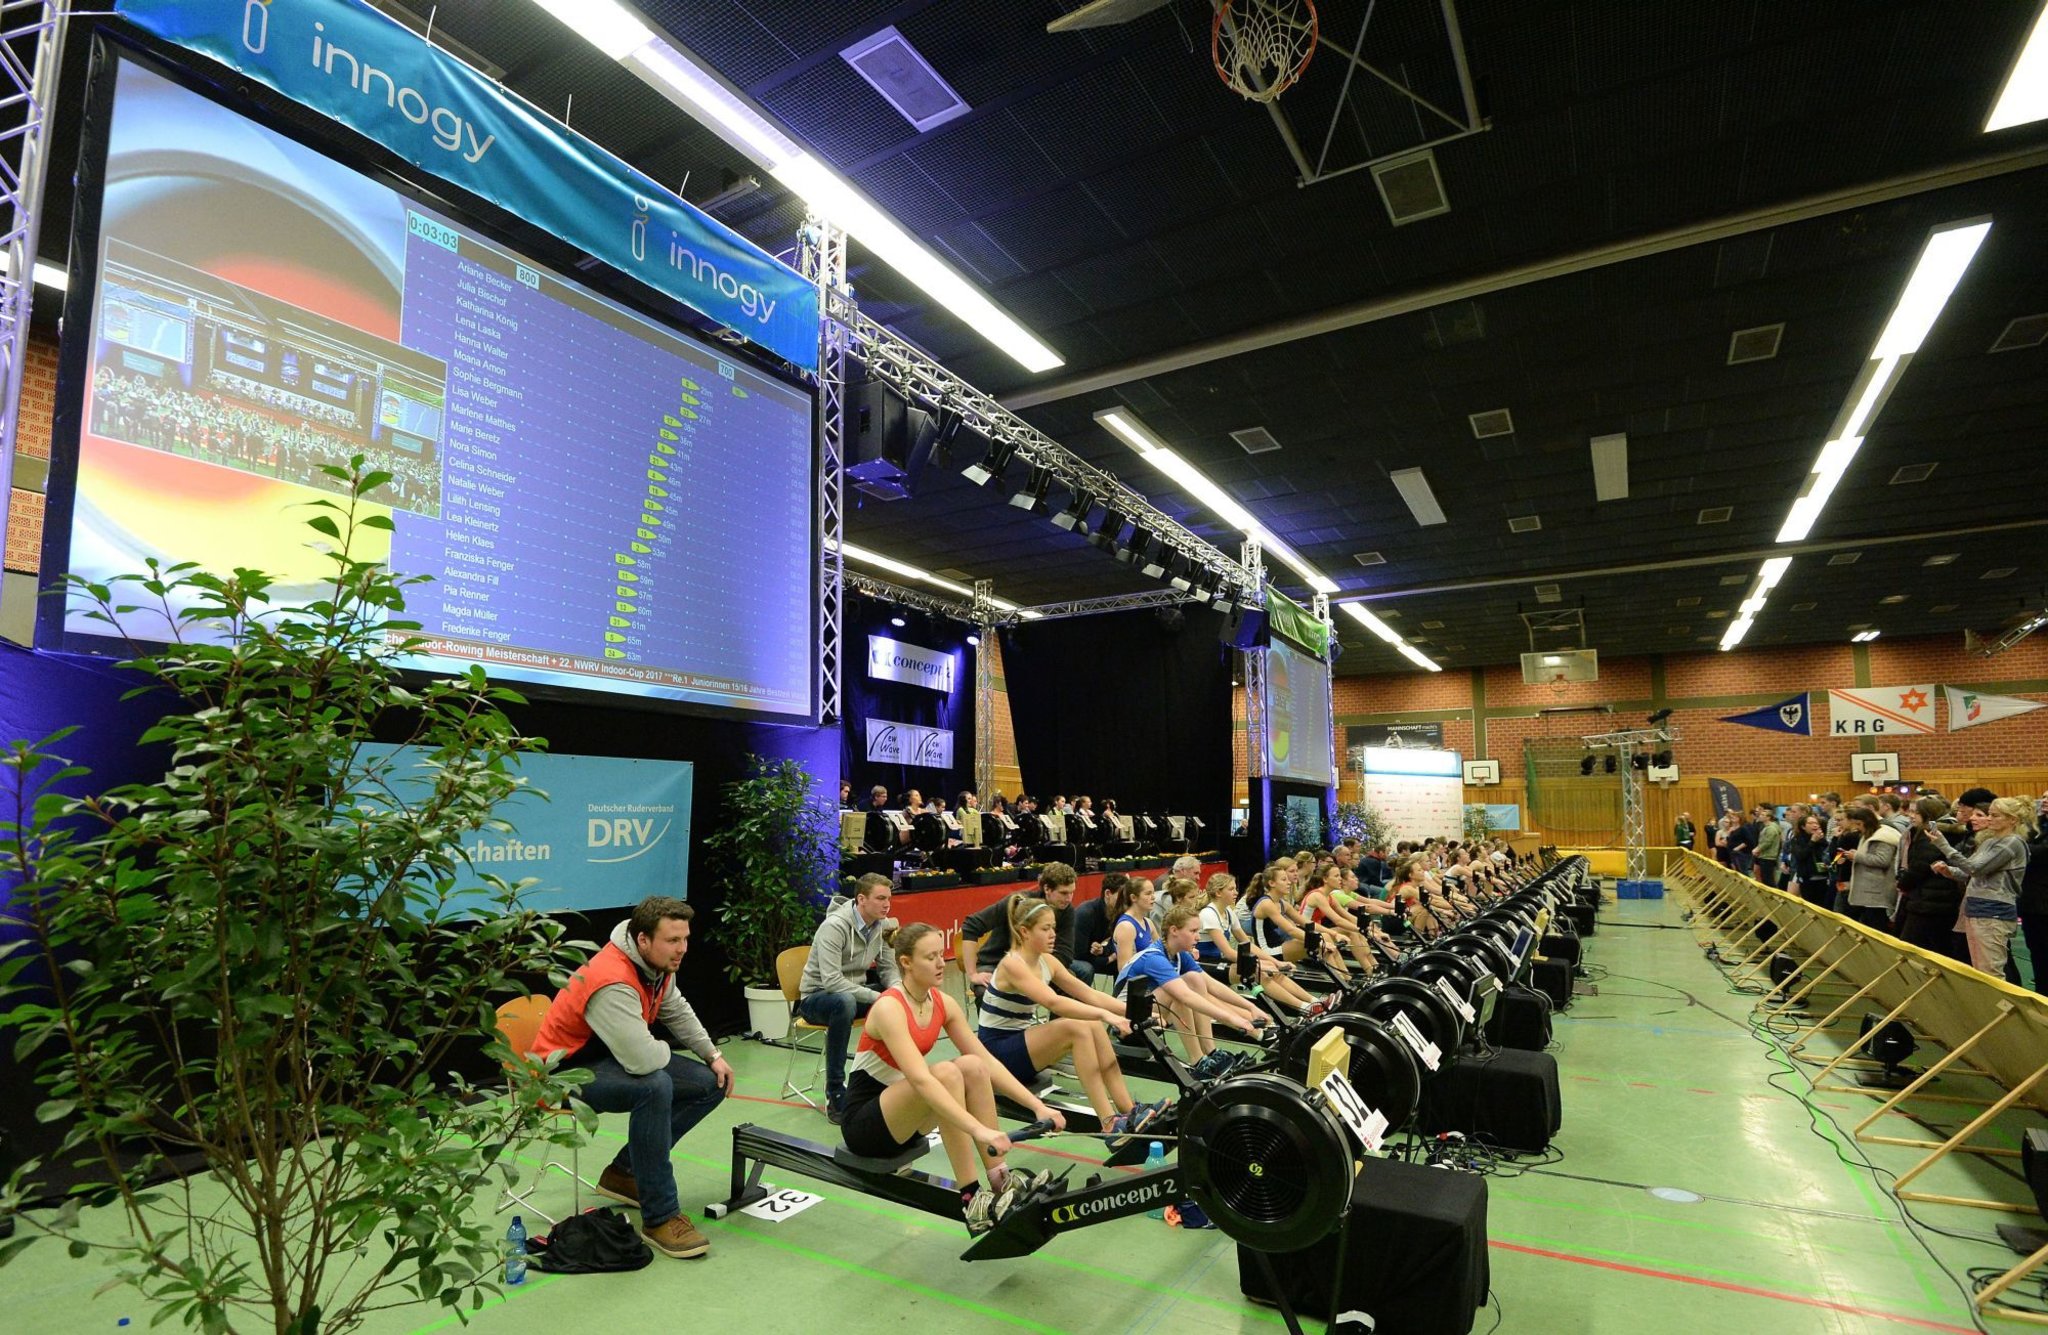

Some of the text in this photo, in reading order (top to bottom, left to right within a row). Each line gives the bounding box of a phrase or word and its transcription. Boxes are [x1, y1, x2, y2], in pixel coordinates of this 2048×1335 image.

[313, 22, 495, 163] innogy
[410, 216, 457, 249] 0:03:03
[458, 262, 513, 293] Ariane Becker
[519, 269, 536, 285] 800
[670, 231, 776, 324] innogy
[457, 280, 507, 307] Julia Bischof
[456, 296, 494, 319] Katharina
[456, 313, 501, 339] Lena Laska
[454, 331, 508, 359] Hanna Walter
[454, 349, 481, 367] Moana
[453, 367, 523, 399] Sophie Bergmann
[452, 385, 498, 408] Lisa Weber
[451, 402, 484, 421] Marlene
[451, 420, 473, 435] Marie
[450, 438, 497, 460] Nora Simon
[449, 456, 516, 483] Celina Schneider
[448, 474, 505, 498] Natalie Weber
[447, 511, 463, 523] Lea
[469, 498, 501, 517] Lensing
[446, 529, 469, 543] Helen
[445, 547, 514, 572] Franziska Fenger
[444, 566, 485, 583] Alexandra
[443, 584, 490, 602] Pia Renner
[443, 603, 472, 618] Magda
[482, 628, 511, 642] Fenger
[486, 648, 550, 665] Meisterschaft
[559, 657, 572, 668] 22.
[574, 660, 600, 672] NWRV
[601, 663, 644, 679] Indoor-Cup
[646, 670, 662, 681] 2017
[691, 677, 730, 690] Juniorinnen
[588, 804, 674, 813] Deutscher Ruderverband
[588, 819, 654, 848] DRV
[1325, 1073, 1370, 1129] 32
[759, 1191, 810, 1214] 32
[1080, 1179, 1177, 1216] concept 2
